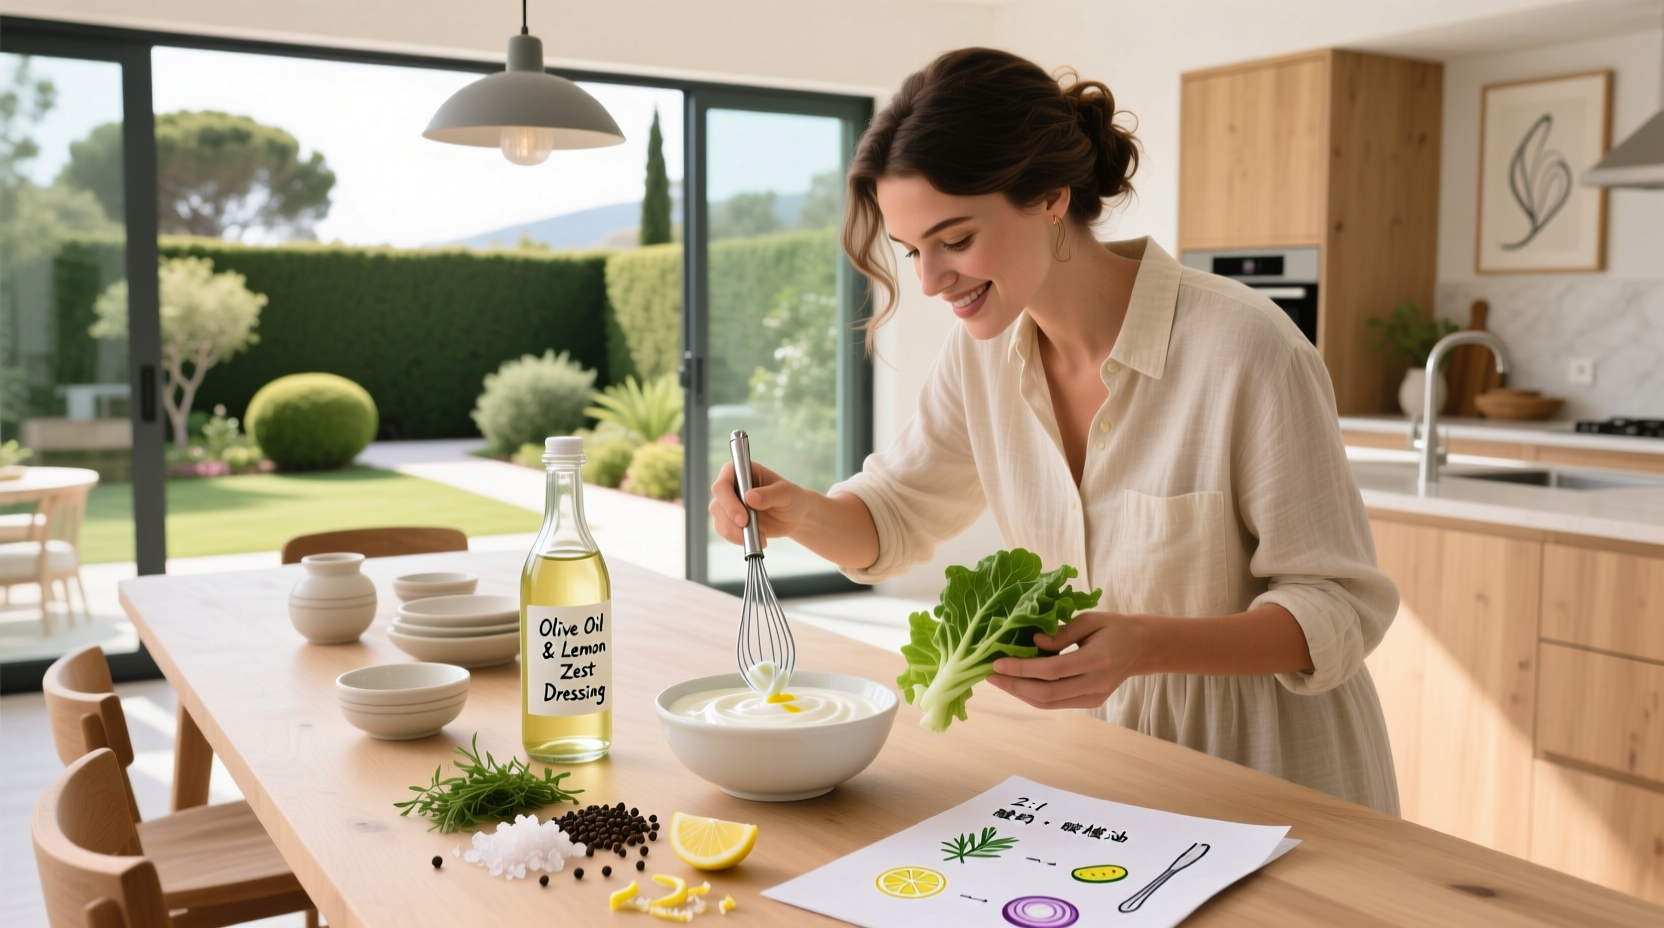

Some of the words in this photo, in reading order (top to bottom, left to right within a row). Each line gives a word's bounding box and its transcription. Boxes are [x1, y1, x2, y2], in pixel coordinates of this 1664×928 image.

[539, 617, 579, 638] Olive
[584, 612, 604, 635] Oil
[542, 641, 555, 660] &
[561, 640, 606, 658] Lemon
[560, 661, 597, 680] Zest
[543, 682, 606, 706] Dressing
[1010, 797, 1048, 811] 2:1
